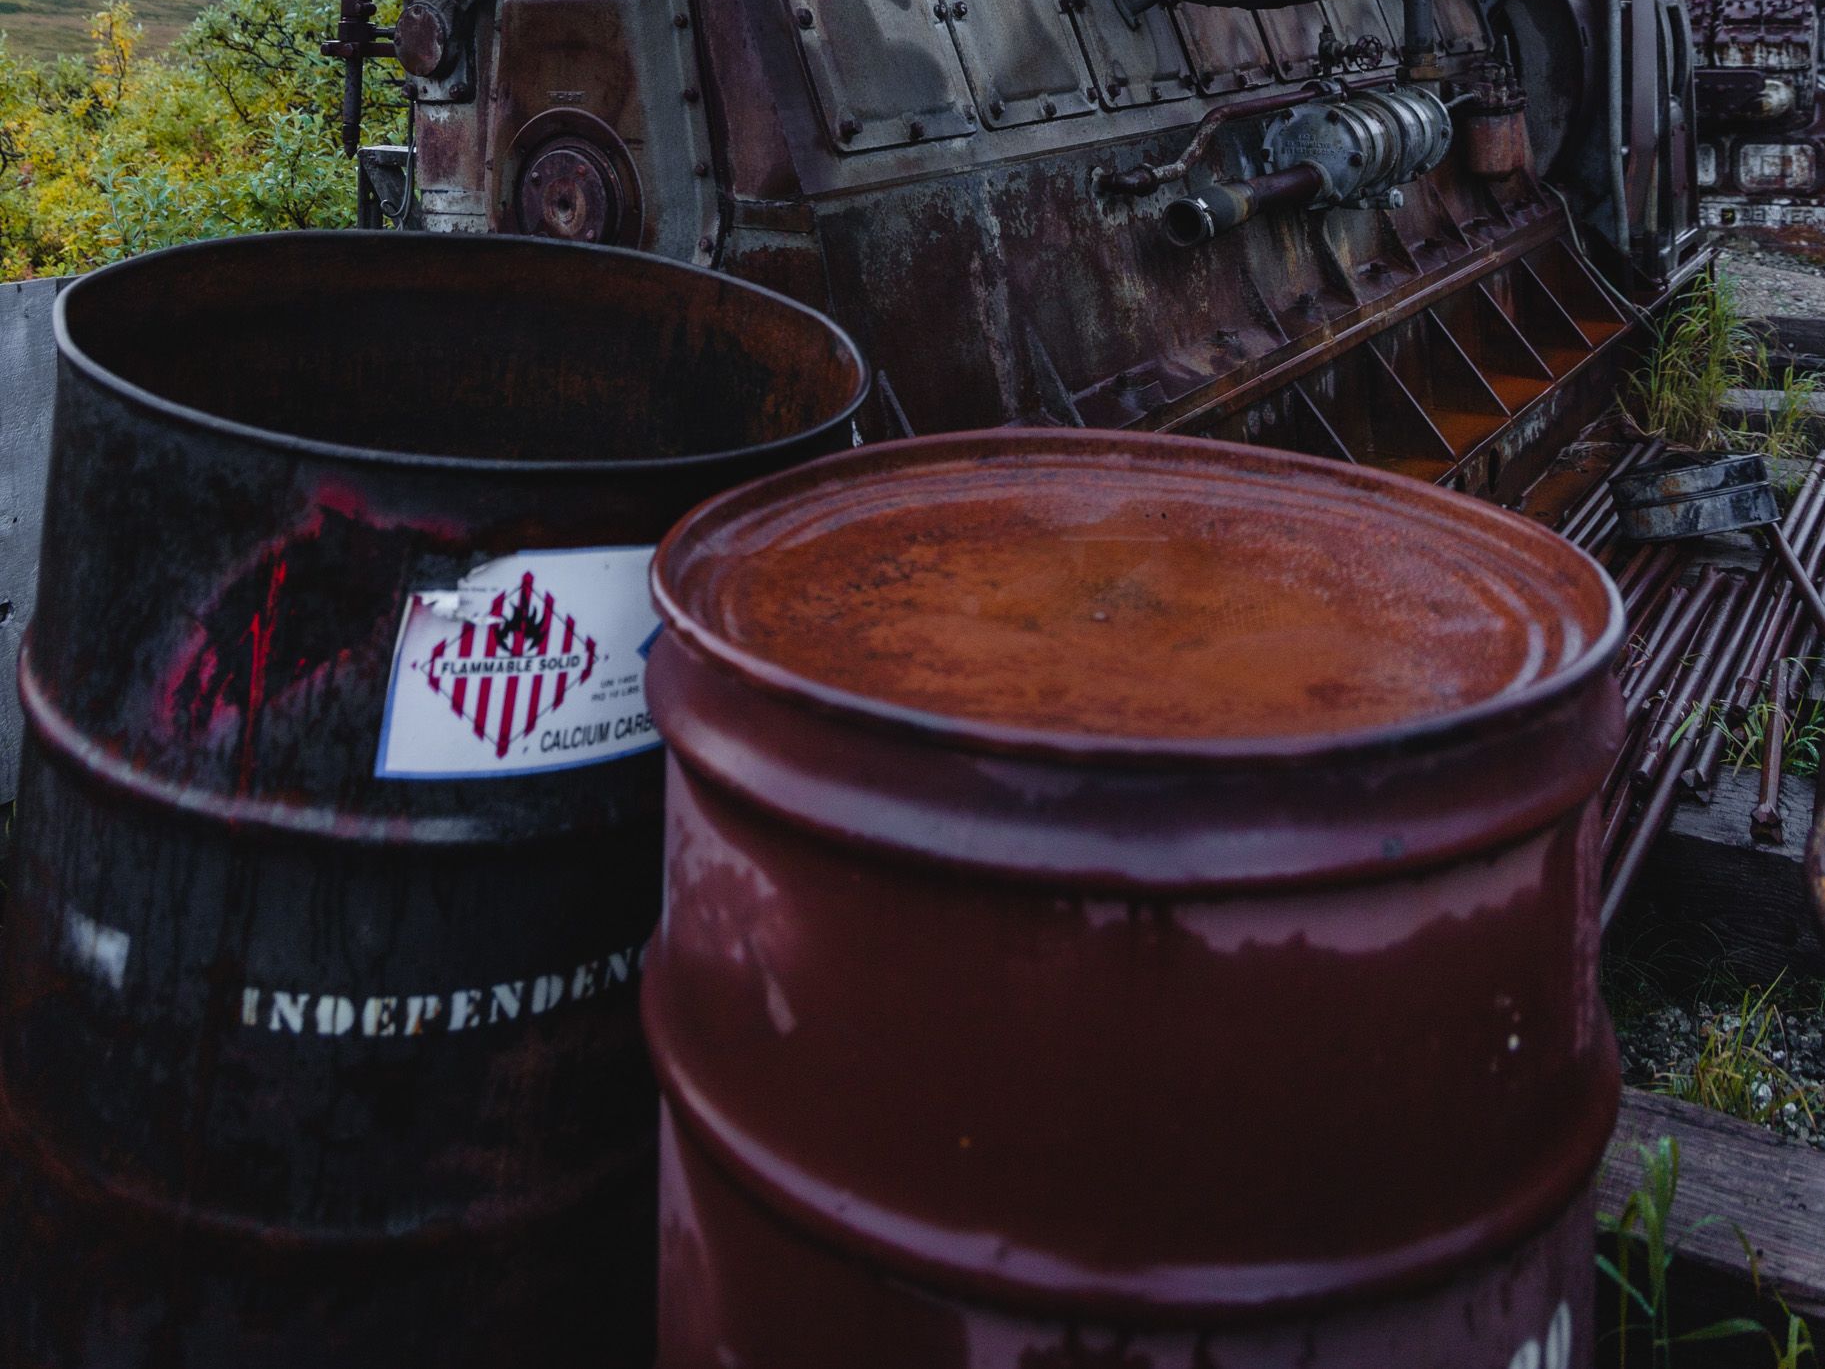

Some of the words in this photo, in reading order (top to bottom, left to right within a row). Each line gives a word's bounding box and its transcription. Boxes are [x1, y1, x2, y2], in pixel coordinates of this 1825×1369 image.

[440, 660, 532, 675] FLAMMABLE
[538, 655, 581, 671] SOLID
[540, 721, 611, 752] CALCIUM
[241, 946, 647, 1037] INDEPENDEN
